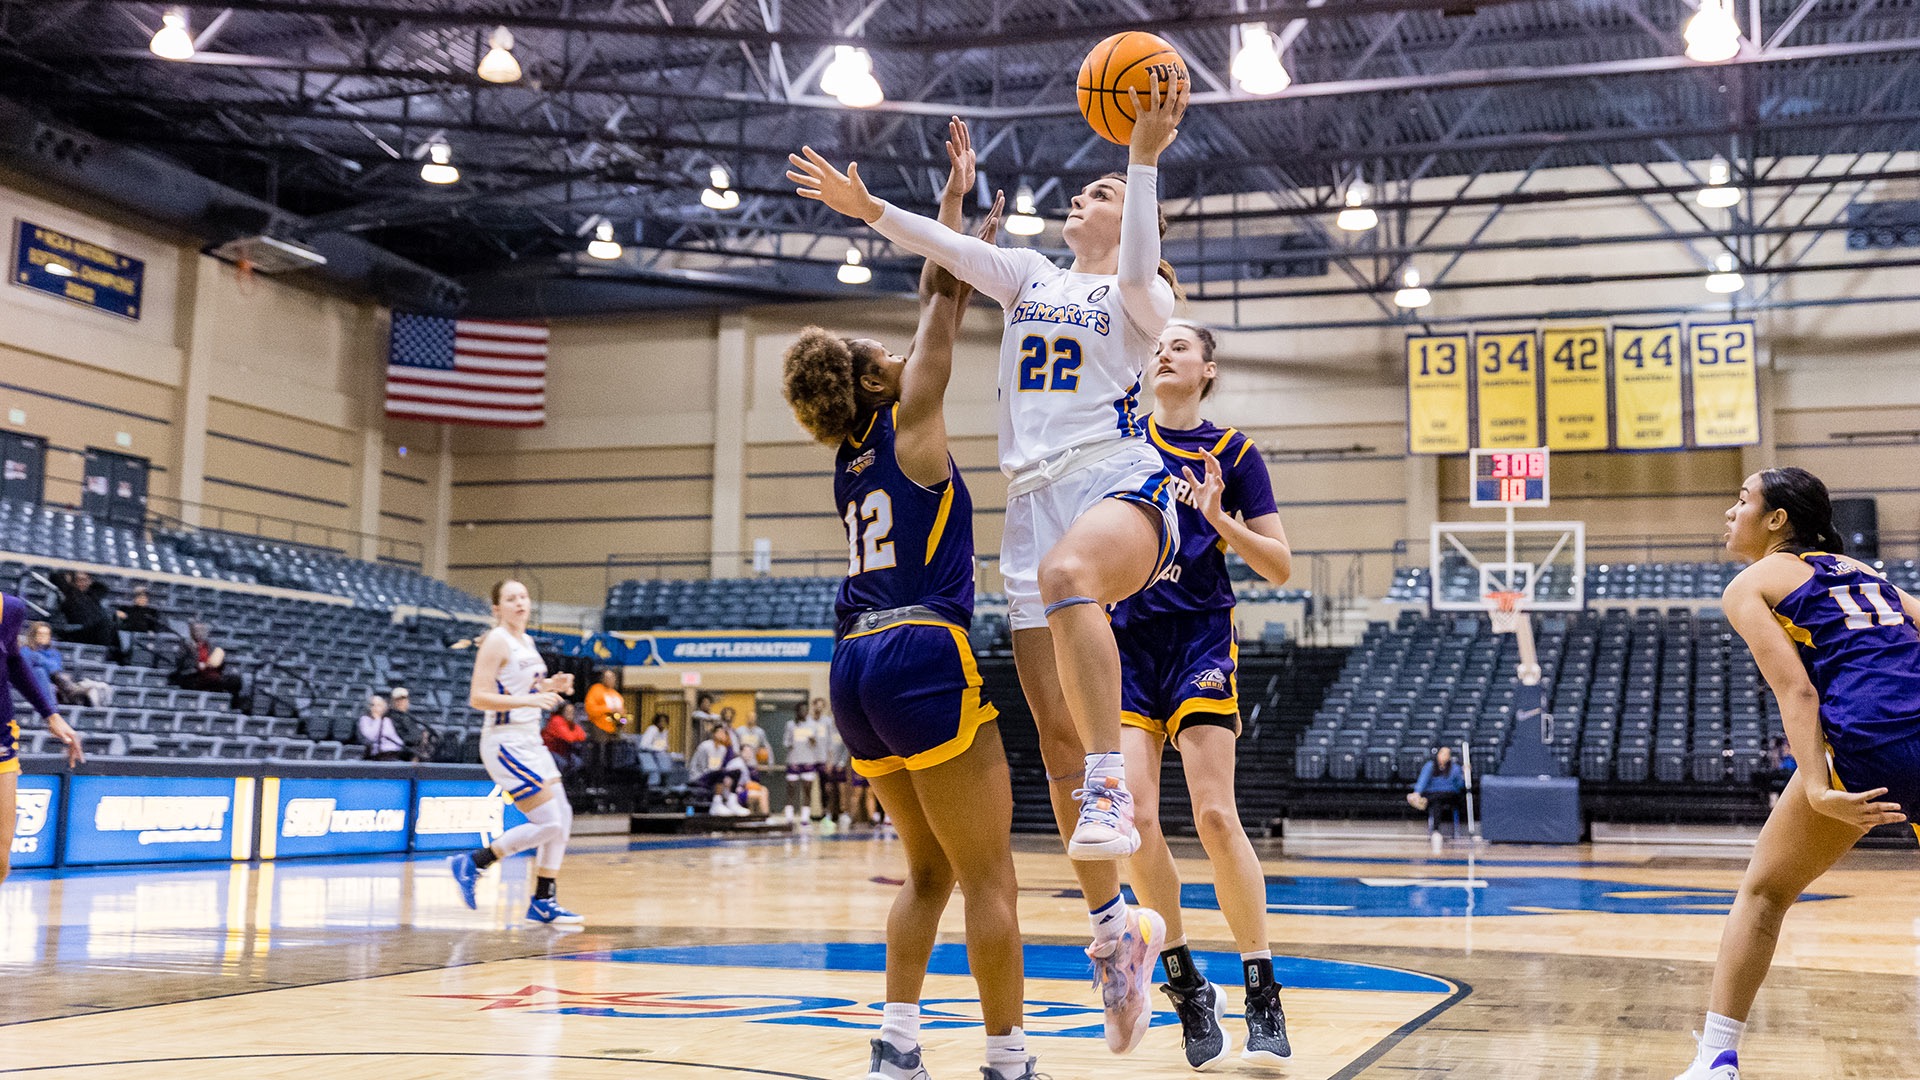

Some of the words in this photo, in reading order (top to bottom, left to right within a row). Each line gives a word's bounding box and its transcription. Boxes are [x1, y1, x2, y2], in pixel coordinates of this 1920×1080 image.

[1018, 333, 1084, 393] 22
[1420, 343, 1456, 375] 13
[1483, 340, 1529, 373] 34
[1553, 338, 1597, 371] 42
[1623, 335, 1673, 368] 44
[1698, 332, 1746, 365] 52
[1500, 478, 1526, 501] 10
[844, 488, 897, 578] 12
[1828, 583, 1905, 630] 11
